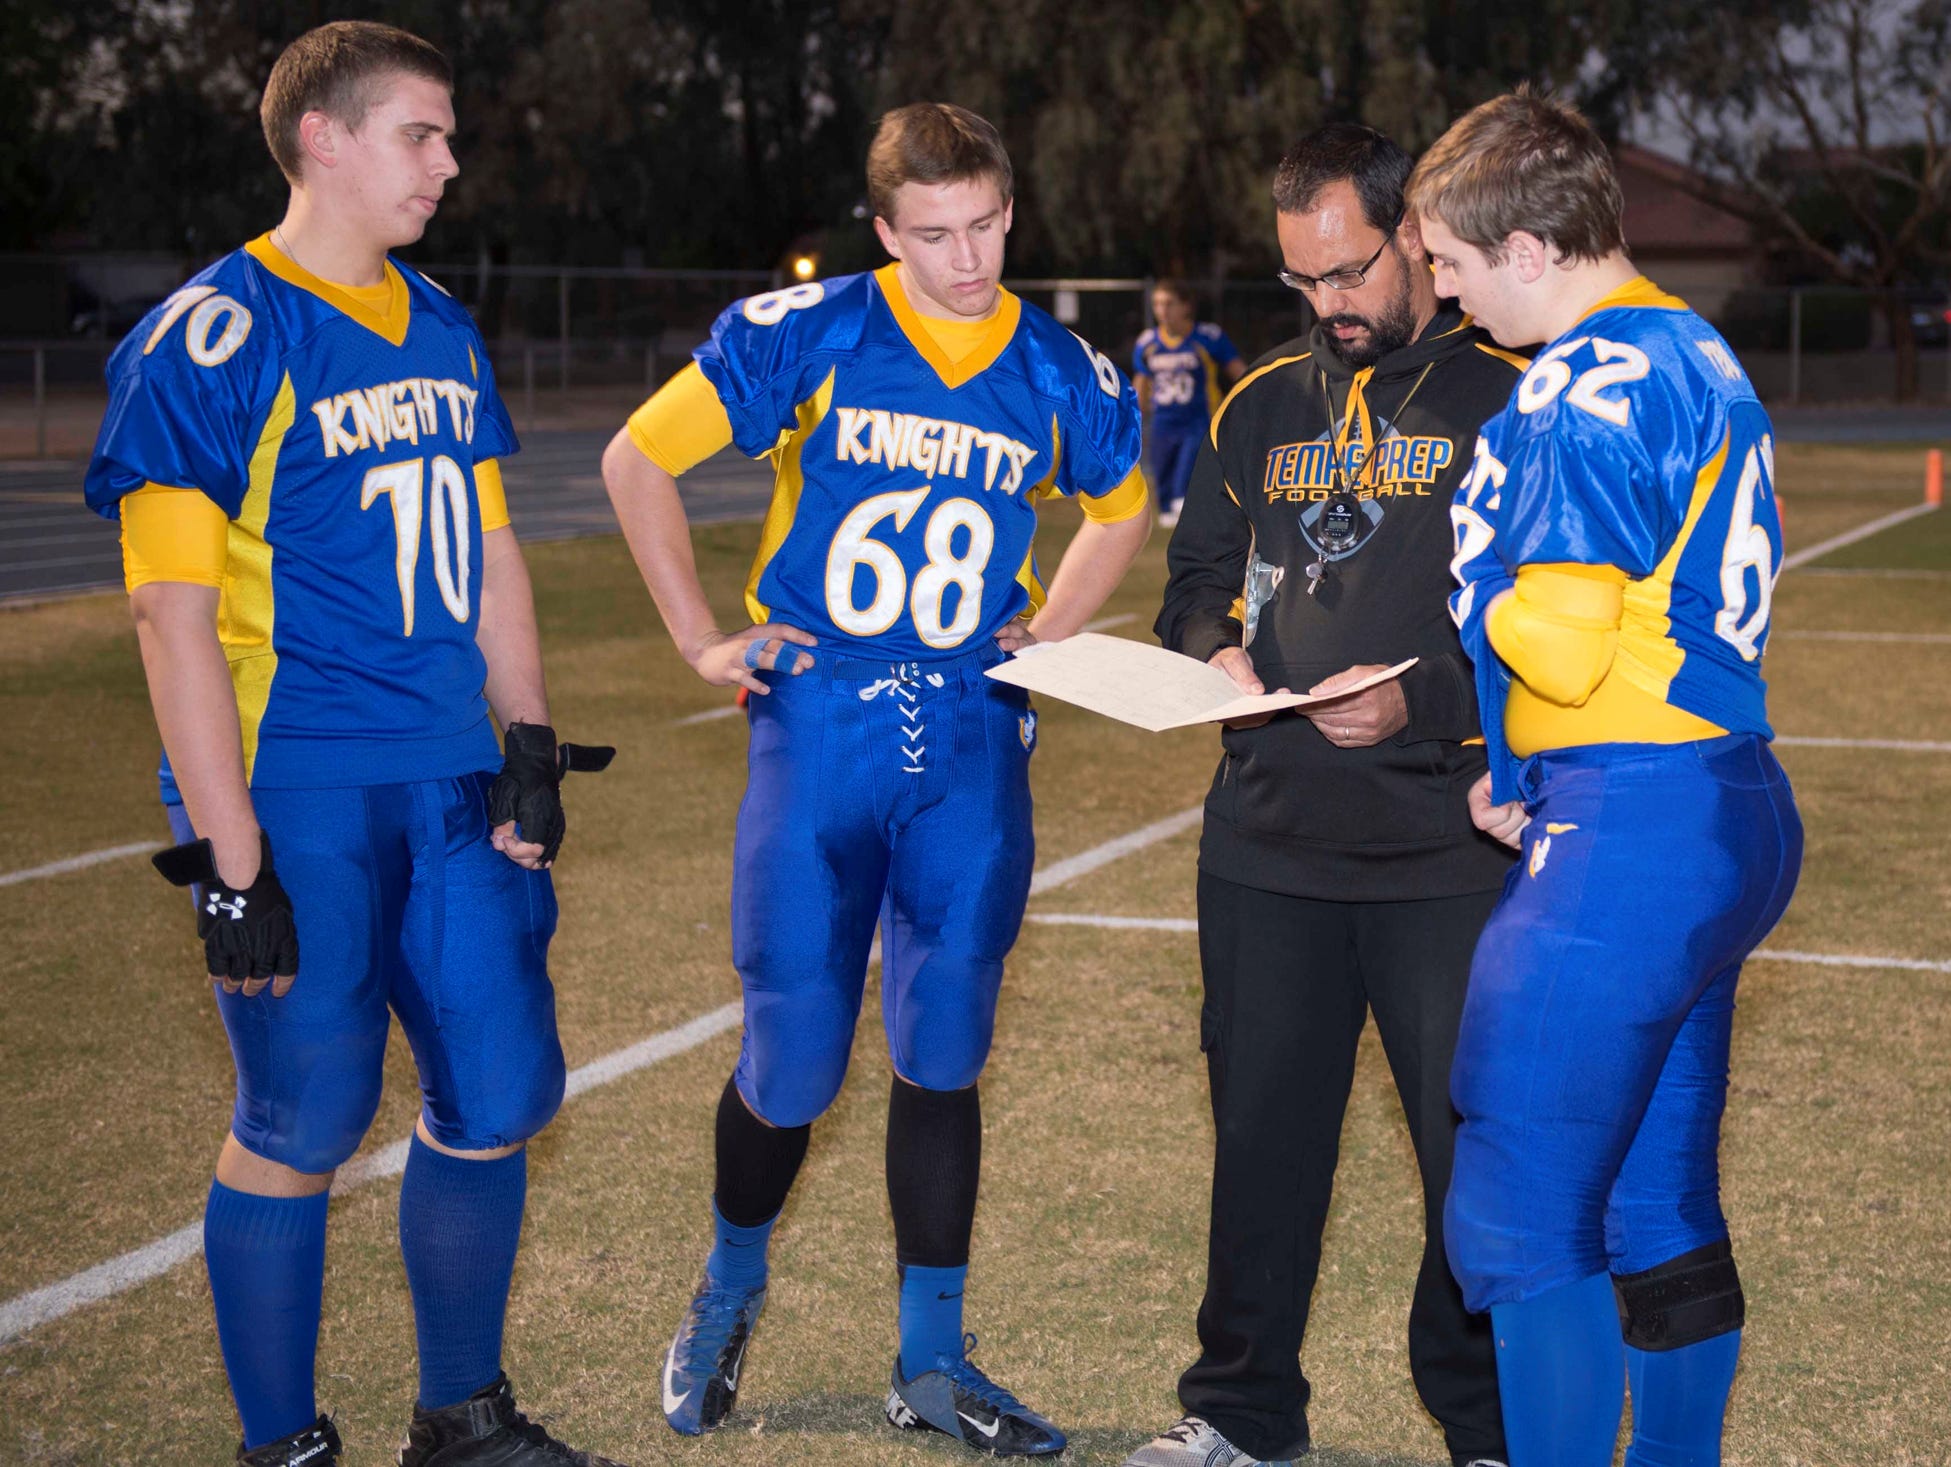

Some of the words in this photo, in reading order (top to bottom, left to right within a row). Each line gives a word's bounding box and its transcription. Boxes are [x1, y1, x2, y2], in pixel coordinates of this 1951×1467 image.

[142, 285, 253, 368] 70
[311, 377, 479, 458] KNIGHTS
[1517, 336, 1651, 427] 62
[836, 408, 1039, 495] KNIGHTS
[1267, 482, 1432, 505] FOOBALL
[1369, 436, 1455, 488] PREP
[360, 454, 470, 637] 70
[825, 485, 995, 649] 68
